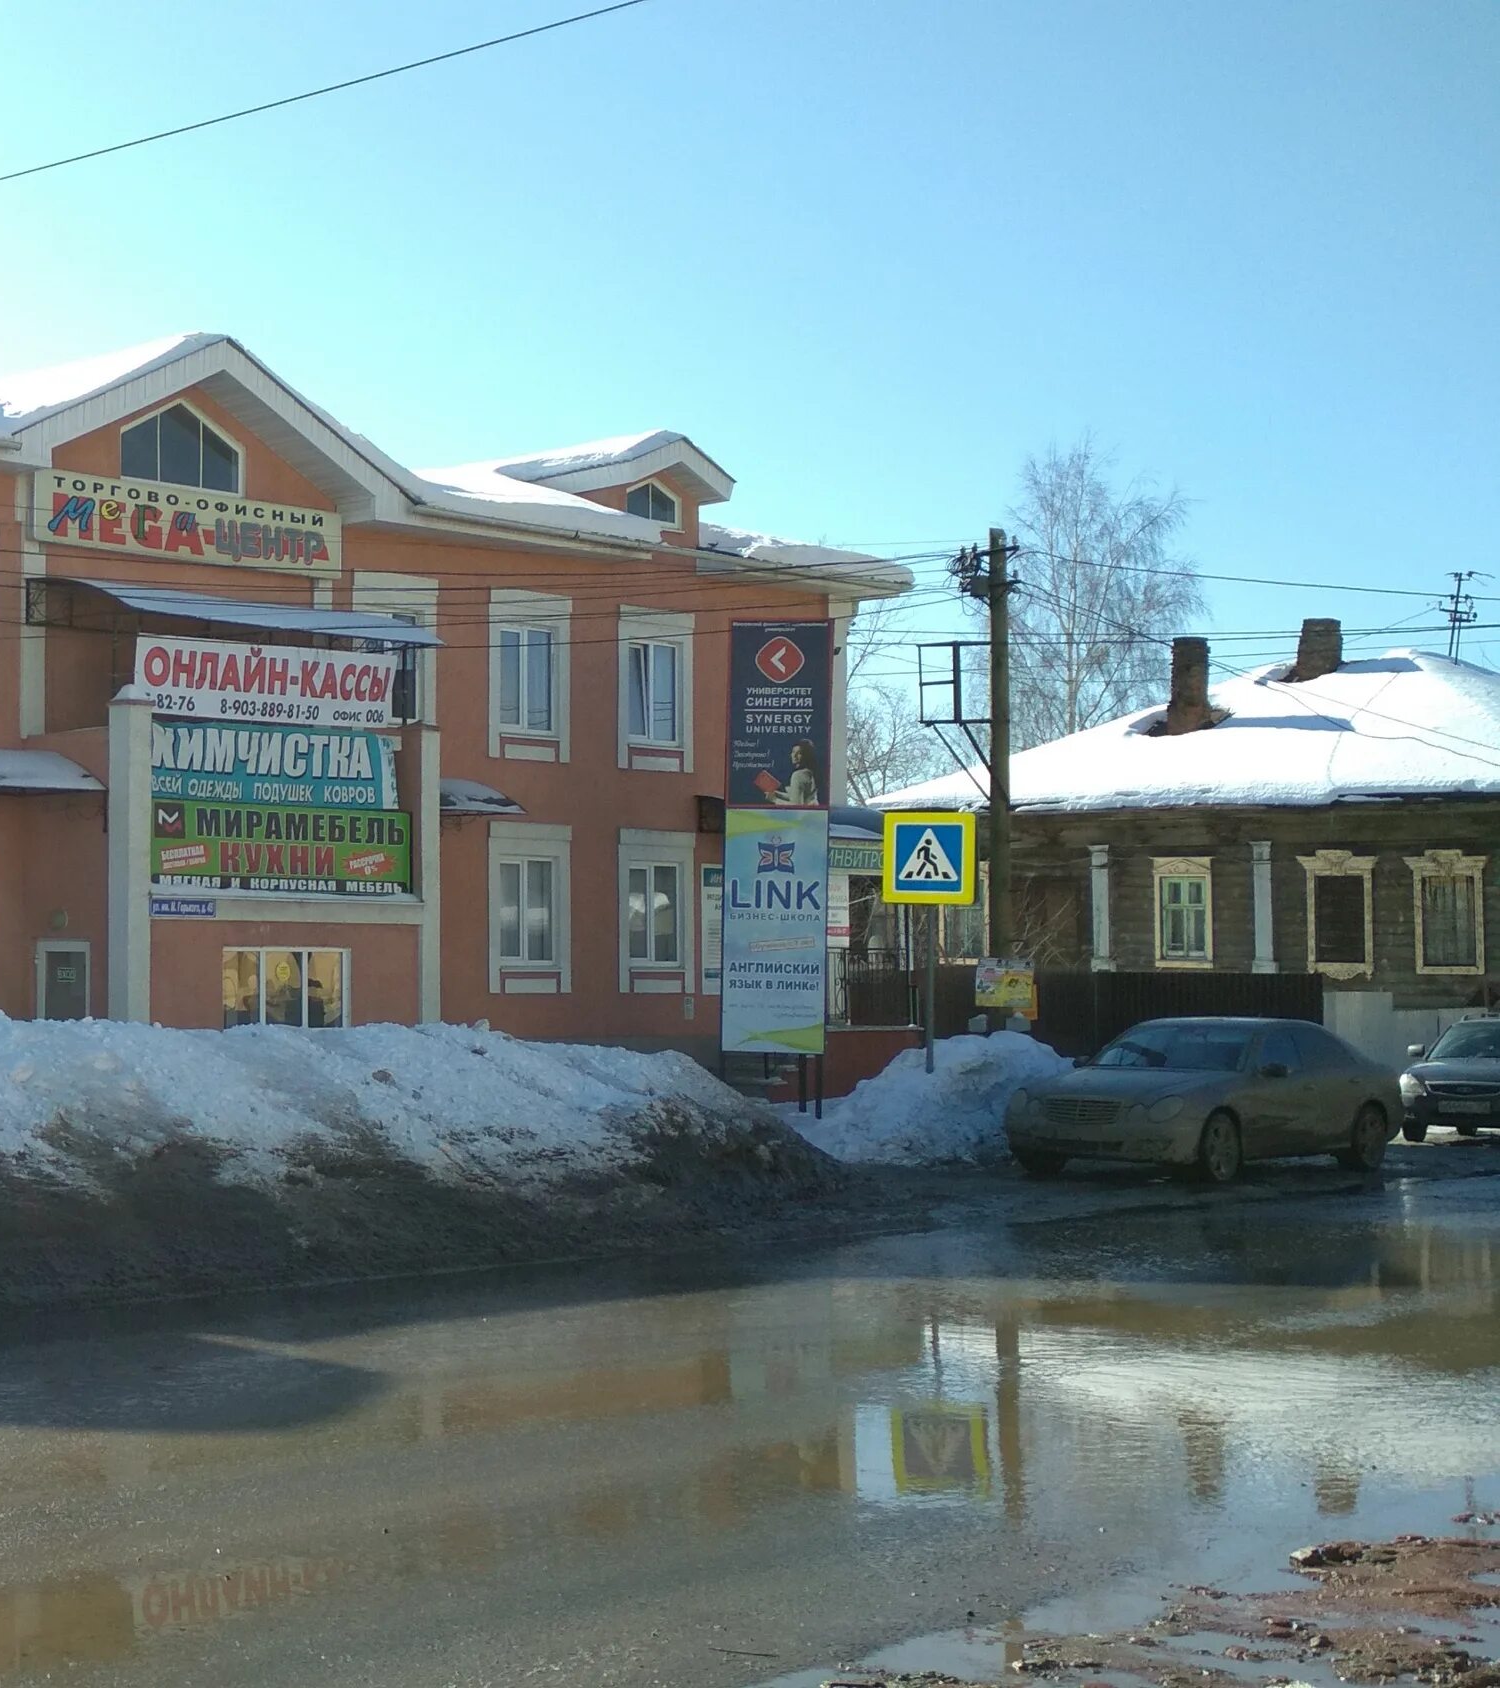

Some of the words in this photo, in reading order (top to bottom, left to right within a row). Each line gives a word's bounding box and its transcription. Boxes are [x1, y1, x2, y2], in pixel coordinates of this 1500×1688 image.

[53, 476, 324, 527] ТОРГОВО-ОФИСНЫЙ
[144, 646, 391, 702] ОНЛАЙН-КАССЫ
[746, 687, 813, 695] УНИВЕРСИТЕТ
[746, 697, 813, 707] СИНЕРГИЯ
[146, 692, 195, 712] 82-76
[220, 698, 320, 721] 8-903-889-81-50
[365, 710, 384, 723] 006
[746, 714, 812, 724] SYNERGY
[746, 725, 811, 734] UNIVERSITY
[152, 724, 374, 779] ХИМЧИСТКА
[152, 773, 182, 795] ВСЕЙ
[187, 779, 243, 800] ОДЕЖДЫ
[253, 782, 314, 804] ПОДУШЕК
[324, 786, 376, 804] КОВРОВ
[196, 808, 405, 846] МИРАМЕБЕЛЬ
[219, 842, 336, 877] КУХНИ
[159, 874, 221, 888] МЯГКАЯ
[231, 876, 240, 888] И
[250, 877, 336, 891] КОРПУСНАЯ
[346, 881, 403, 895] МЕБЕЛЬ
[731, 880, 821, 910] LINK
[730, 912, 821, 922] БИЗНЕС-ШКОЛА
[729, 961, 820, 974] АНГЛИЙСКИЙ
[729, 979, 762, 989] ЯЗЫК
[766, 980, 773, 989] В
[776, 981, 819, 991] ЛИНКе!
